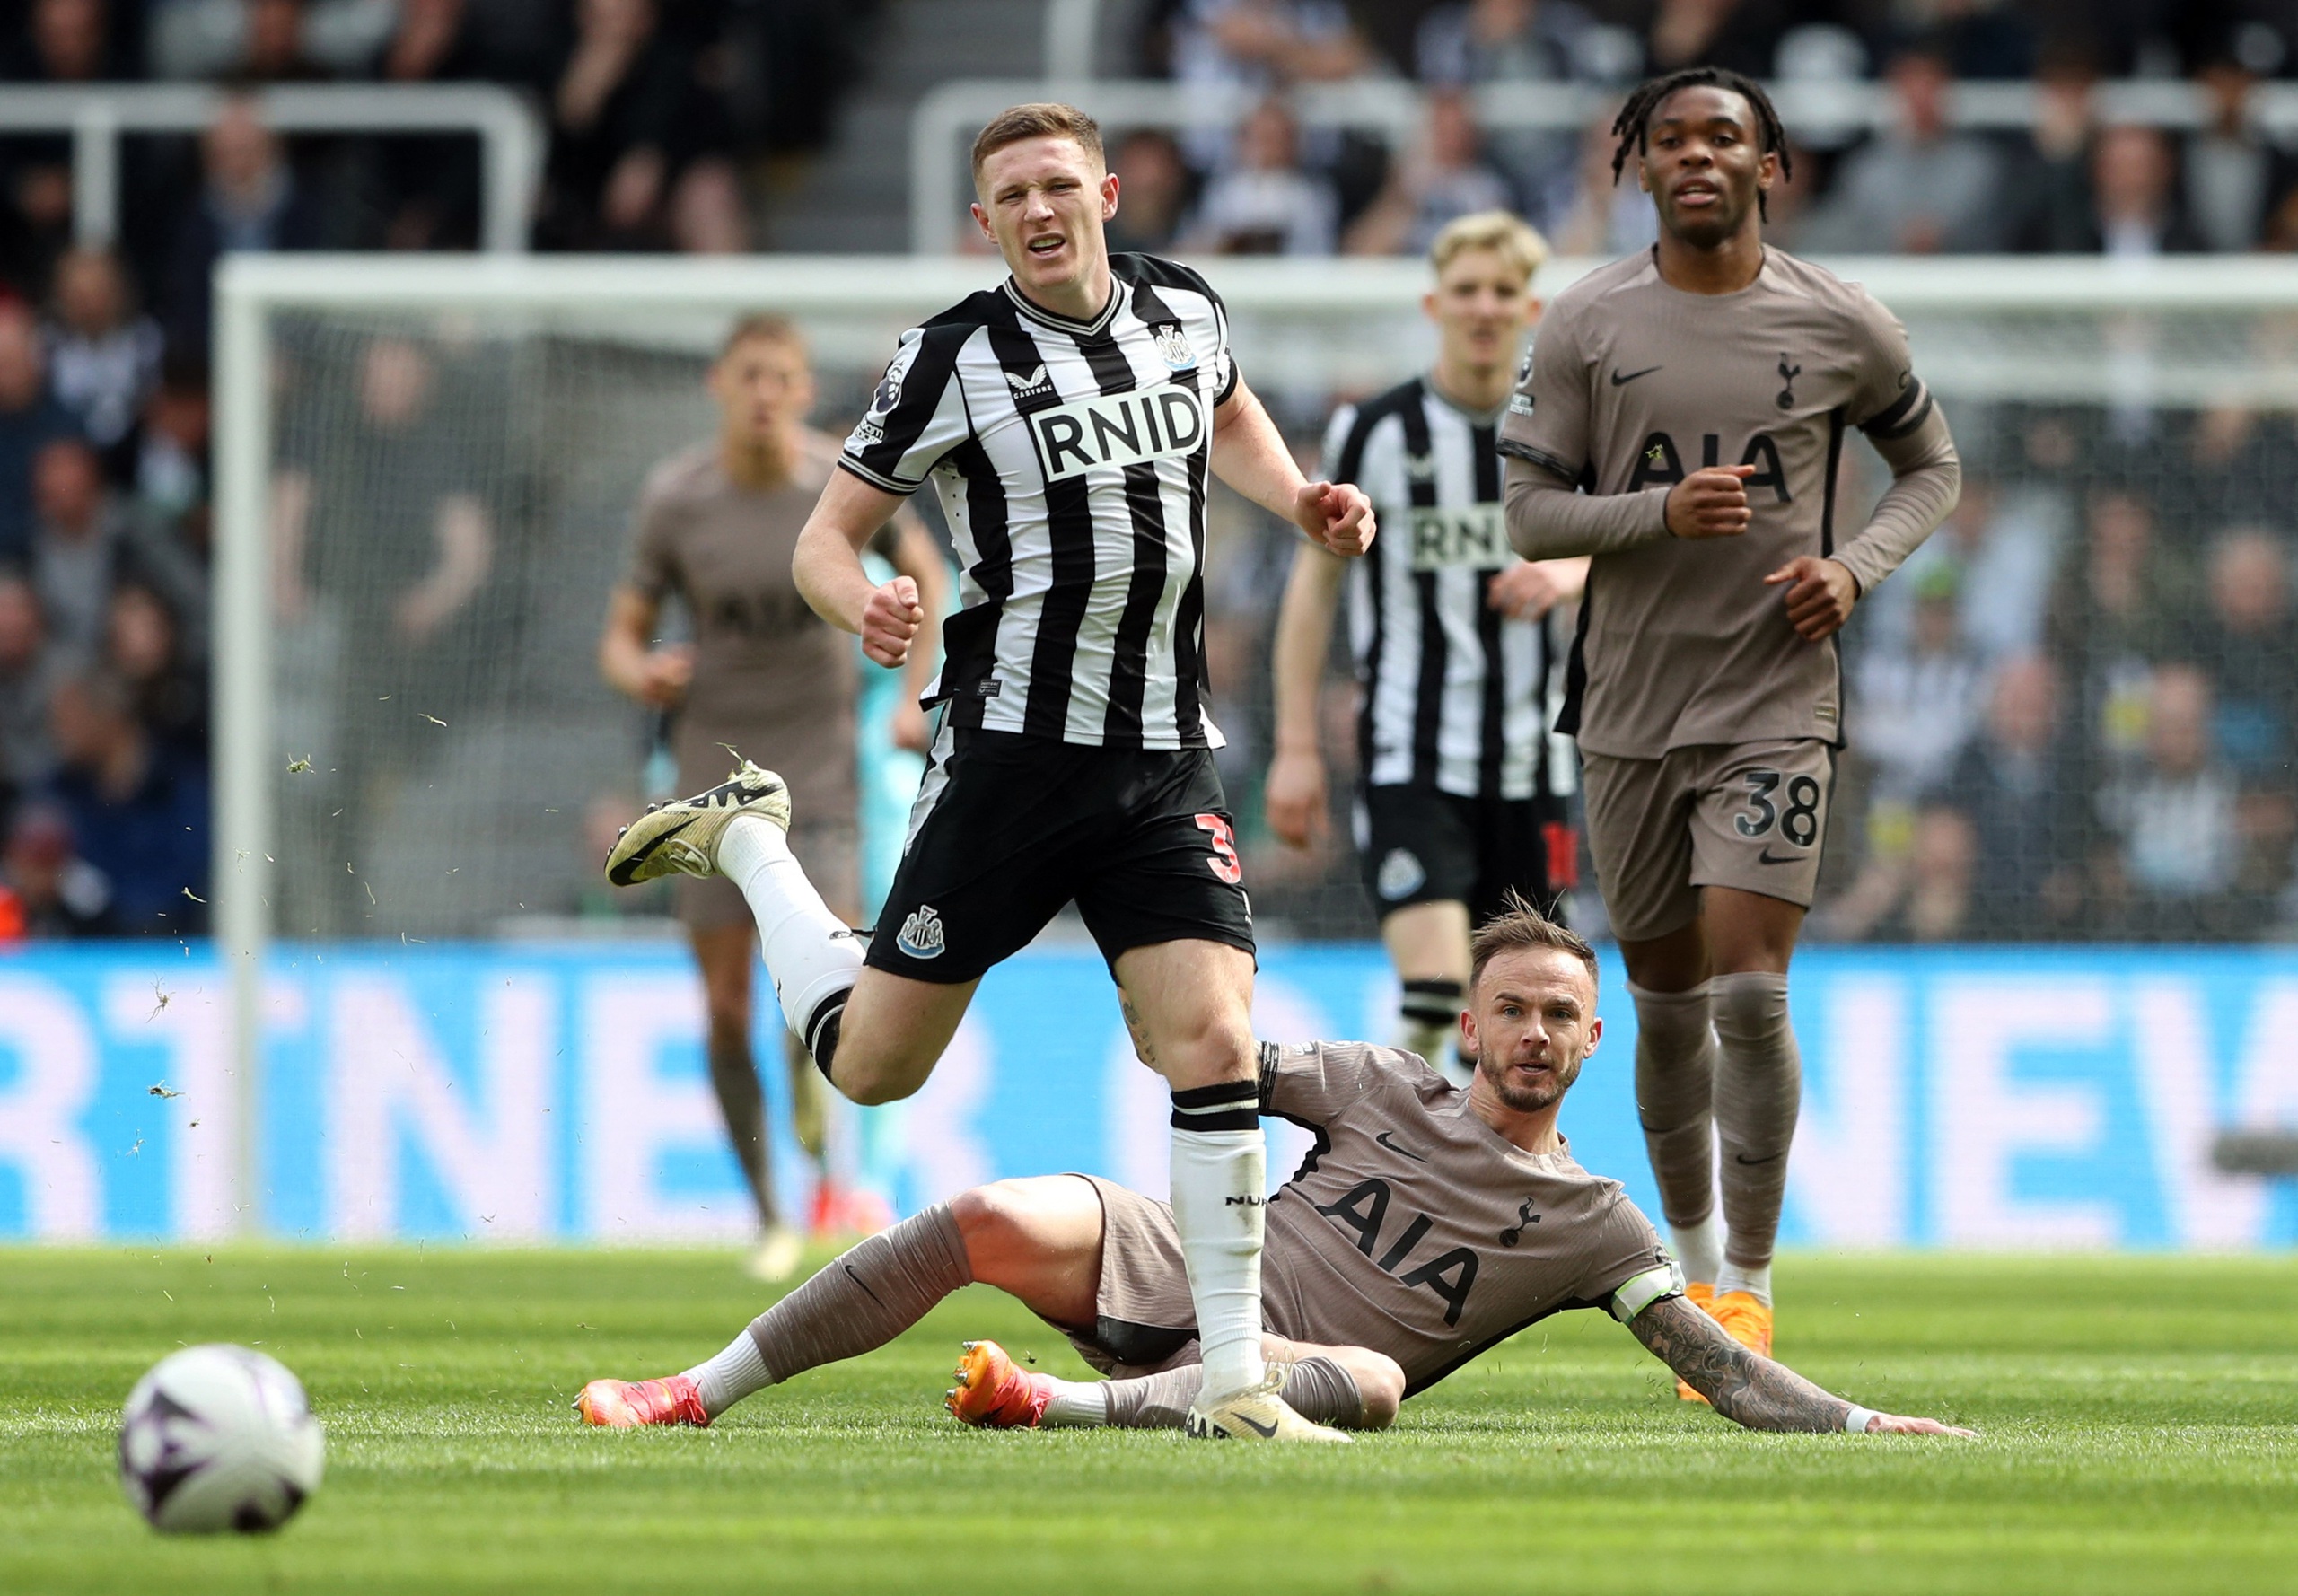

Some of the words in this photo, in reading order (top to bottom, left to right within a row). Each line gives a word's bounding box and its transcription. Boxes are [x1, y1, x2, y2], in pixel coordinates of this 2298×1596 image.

[1013, 384, 1052, 399] CASTORE
[1038, 392, 1201, 475] RNID
[1414, 512, 1499, 563] RN
[1733, 771, 1820, 850] 38
[1193, 813, 1242, 884] 3
[1314, 1178, 1479, 1329] AIA
